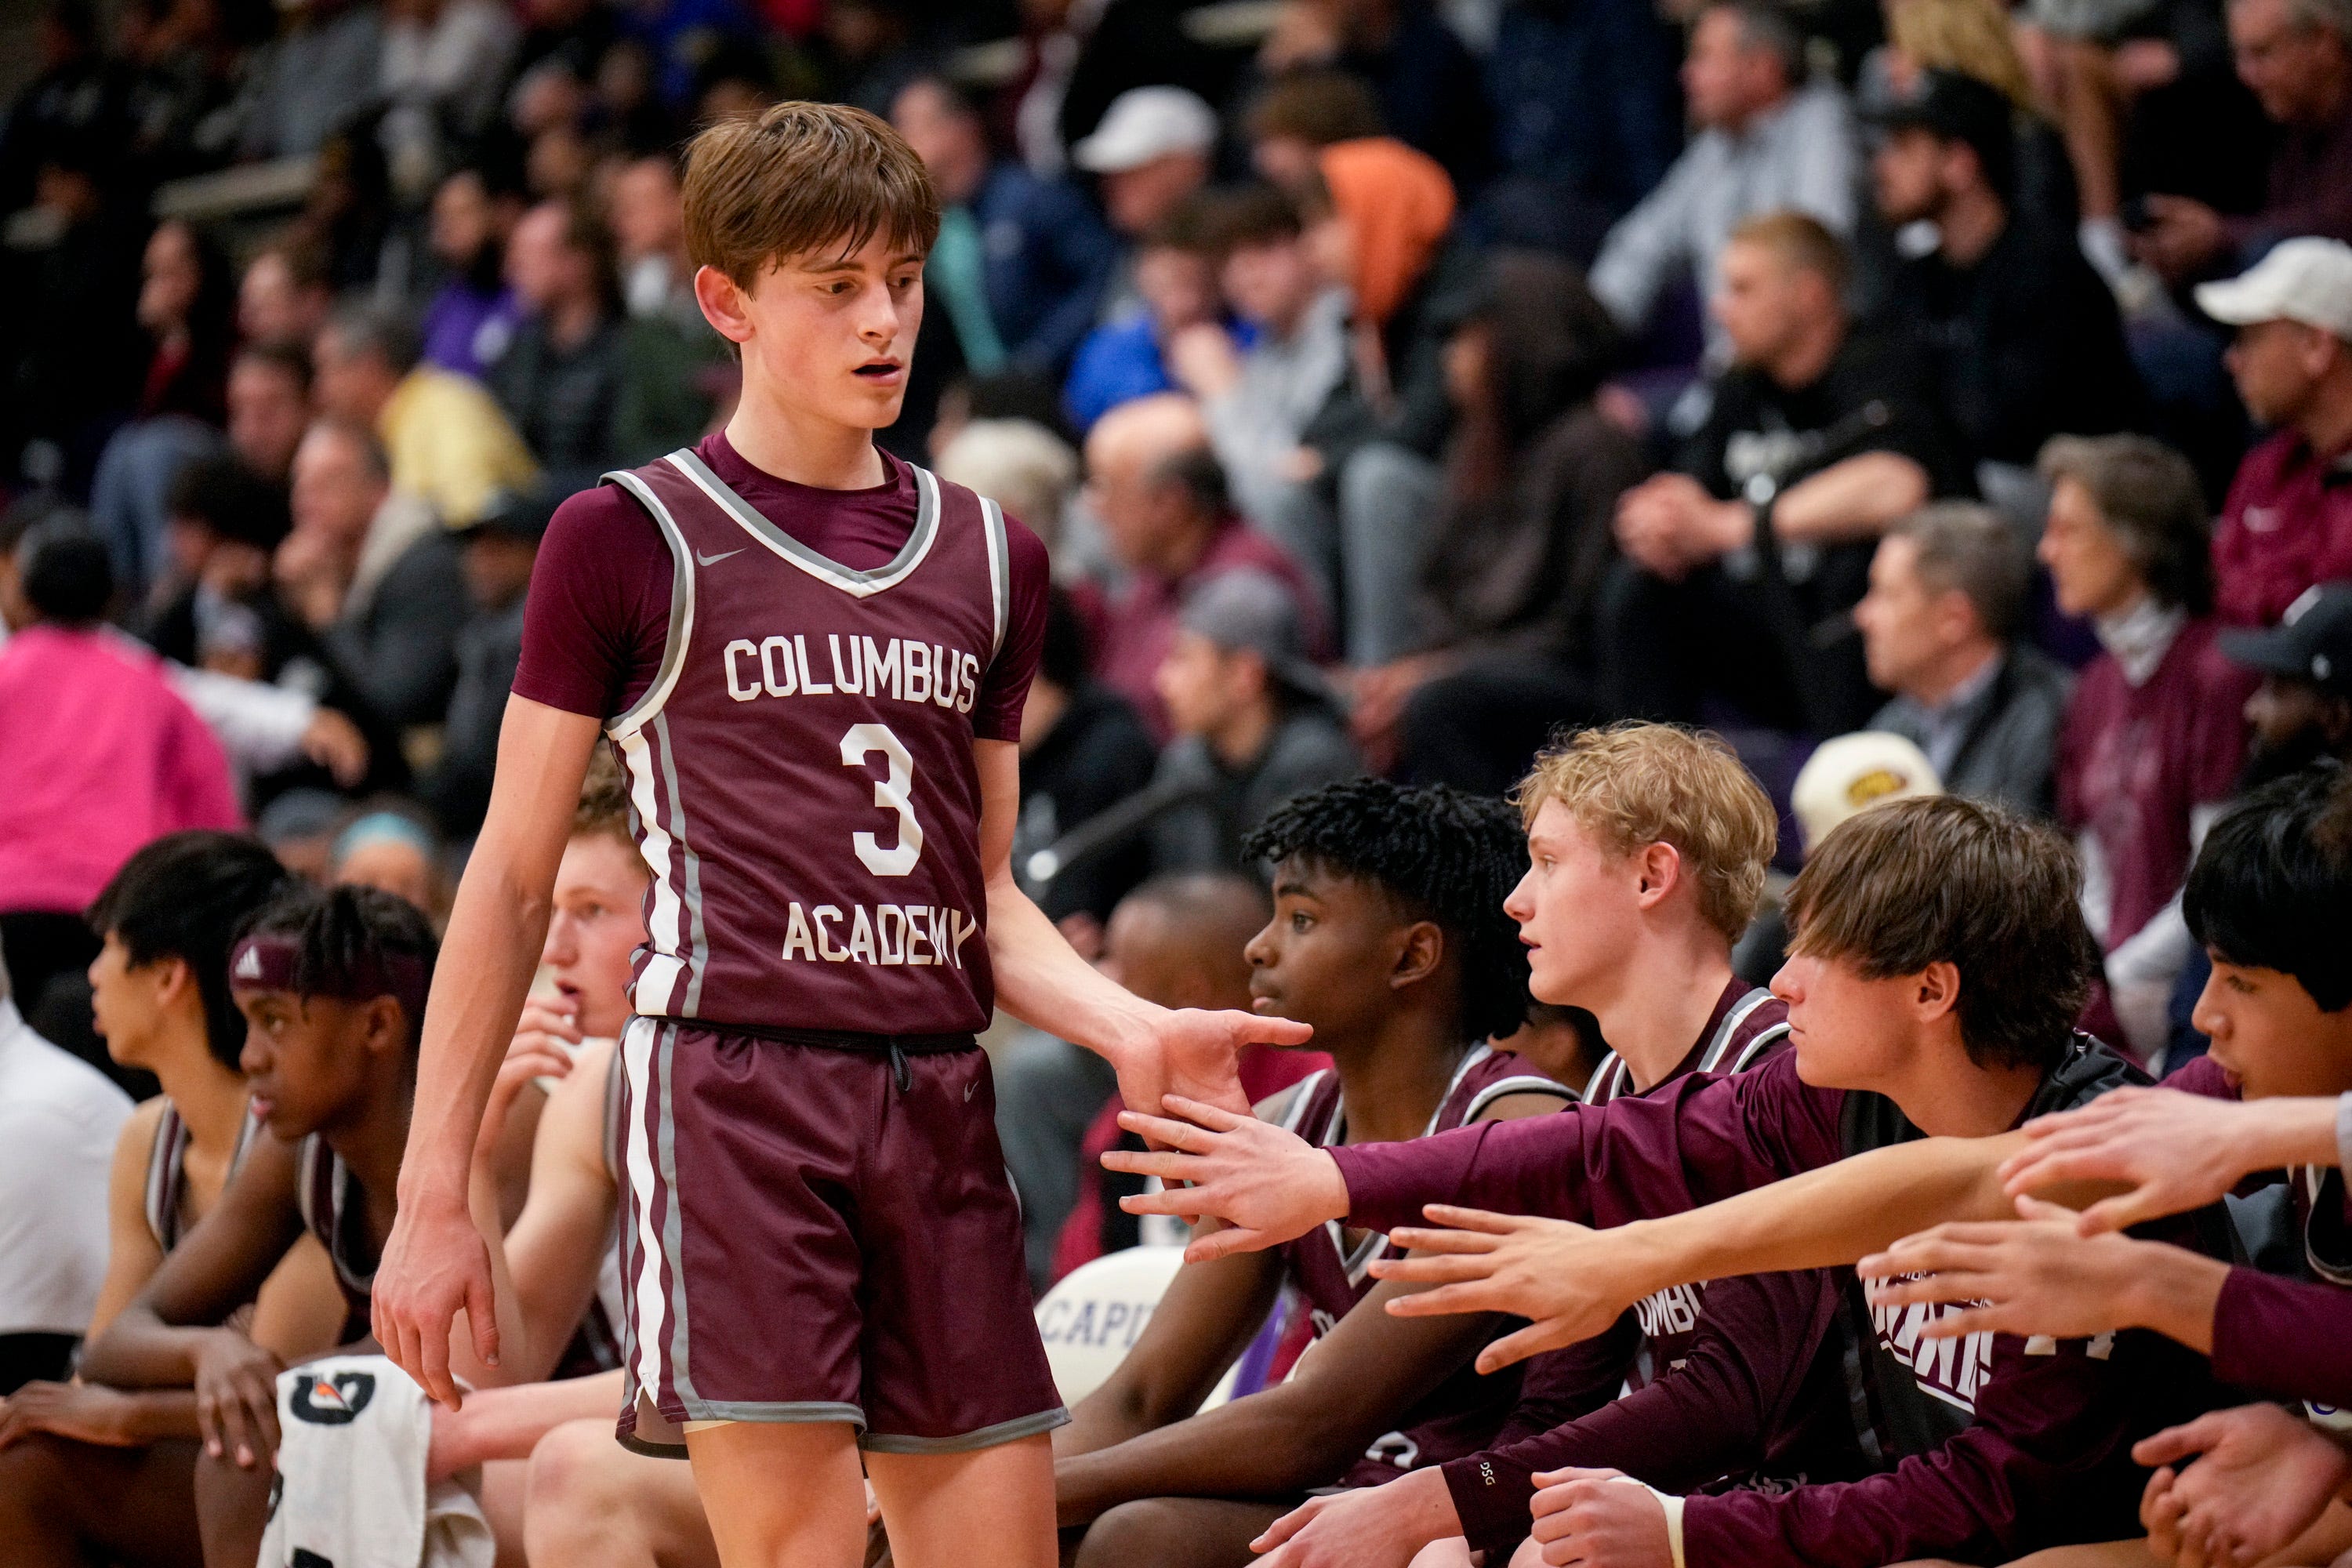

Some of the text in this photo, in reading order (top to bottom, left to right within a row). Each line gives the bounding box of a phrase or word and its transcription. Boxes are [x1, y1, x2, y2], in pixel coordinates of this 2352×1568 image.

[723, 633, 979, 713] COLUMBUS
[839, 723, 924, 877] 3
[782, 902, 978, 970] ACADEMY
[1040, 1298, 1156, 1349] CAPI
[1479, 1461, 1496, 1486] DSG
